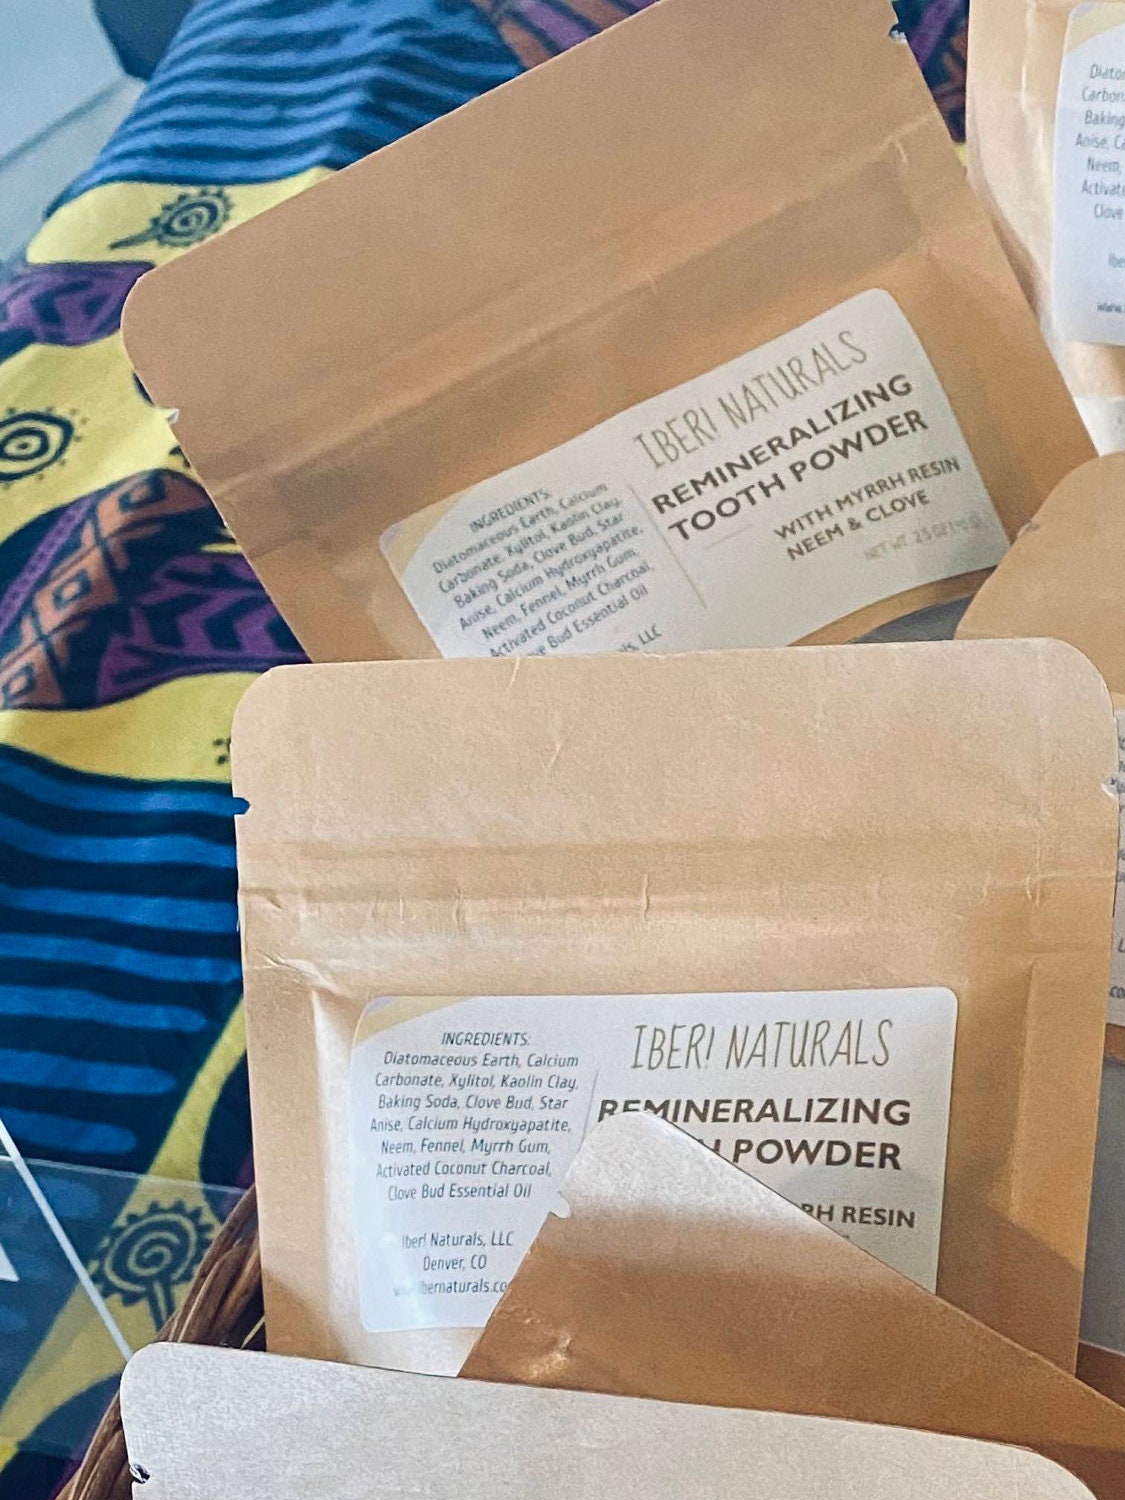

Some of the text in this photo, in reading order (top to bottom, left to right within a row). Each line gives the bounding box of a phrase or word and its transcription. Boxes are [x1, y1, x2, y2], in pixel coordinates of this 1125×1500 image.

[717, 330, 867, 429] NATURALS
[651, 374, 912, 515] REMINERALIZING
[668, 472, 786, 540] TOOTH
[788, 410, 928, 483] POWDER
[773, 504, 833, 539] WITH
[834, 473, 906, 511] MYRRH
[906, 457, 961, 483] RESIN
[786, 523, 845, 561] NEEM
[847, 517, 862, 531] &
[865, 489, 930, 522] CLOVE
[546, 626, 573, 649] Bud
[571, 594, 630, 634] Essential
[441, 1031, 528, 1047] INGREDIENTS:
[725, 1018, 893, 1070] NATURALS
[383, 1050, 478, 1067] Diatomaceous
[526, 1052, 579, 1068] Calcium
[500, 1074, 543, 1089] Kaolin
[378, 1093, 422, 1112] Baking
[425, 1093, 460, 1110] Soda,
[465, 1093, 502, 1110] Clove
[539, 1095, 569, 1110] Star
[597, 1098, 912, 1128] REMINERALIZING
[407, 1115, 459, 1131] Calcium
[470, 1137, 514, 1157] Myrrh
[518, 1138, 551, 1155] Gum,
[732, 1138, 902, 1171] POWDER
[376, 1160, 552, 1178] Activated Coconut Charcoal,
[388, 1182, 532, 1202] Clove Bud Essential Oil
[841, 1205, 916, 1229] RESIN
[430, 1231, 486, 1248] Naturals,
[490, 1230, 514, 1247] LLC
[470, 1253, 488, 1270] CO
